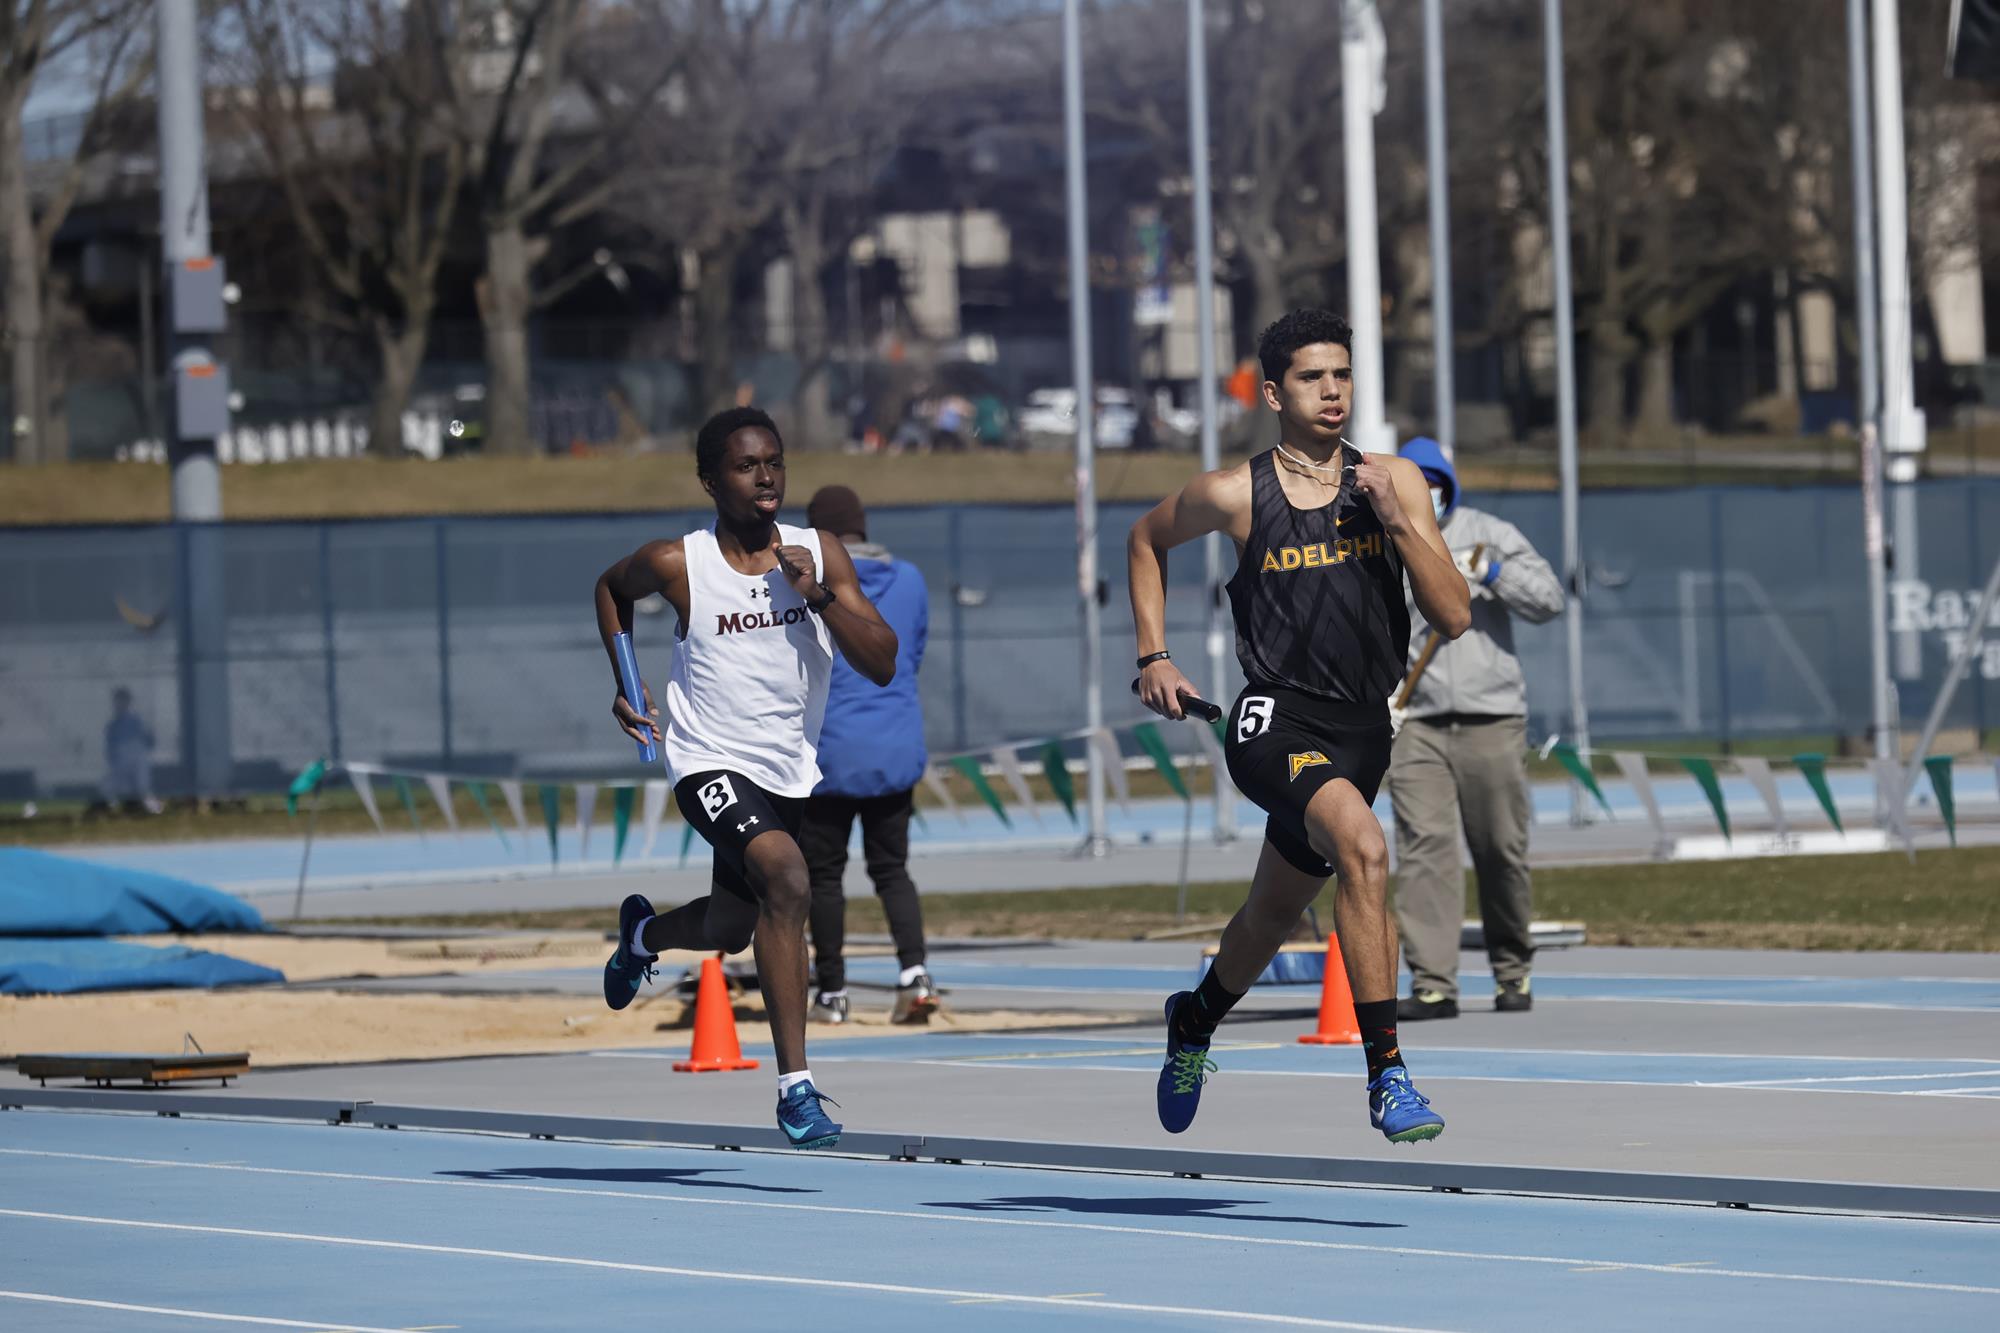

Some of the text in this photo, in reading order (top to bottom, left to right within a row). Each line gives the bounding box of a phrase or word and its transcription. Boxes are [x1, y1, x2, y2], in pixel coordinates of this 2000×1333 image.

[1261, 534, 1383, 574] ADELPHI
[715, 606, 808, 636] MOLLOY
[1240, 700, 1266, 739] 5
[704, 782, 729, 813] 3
